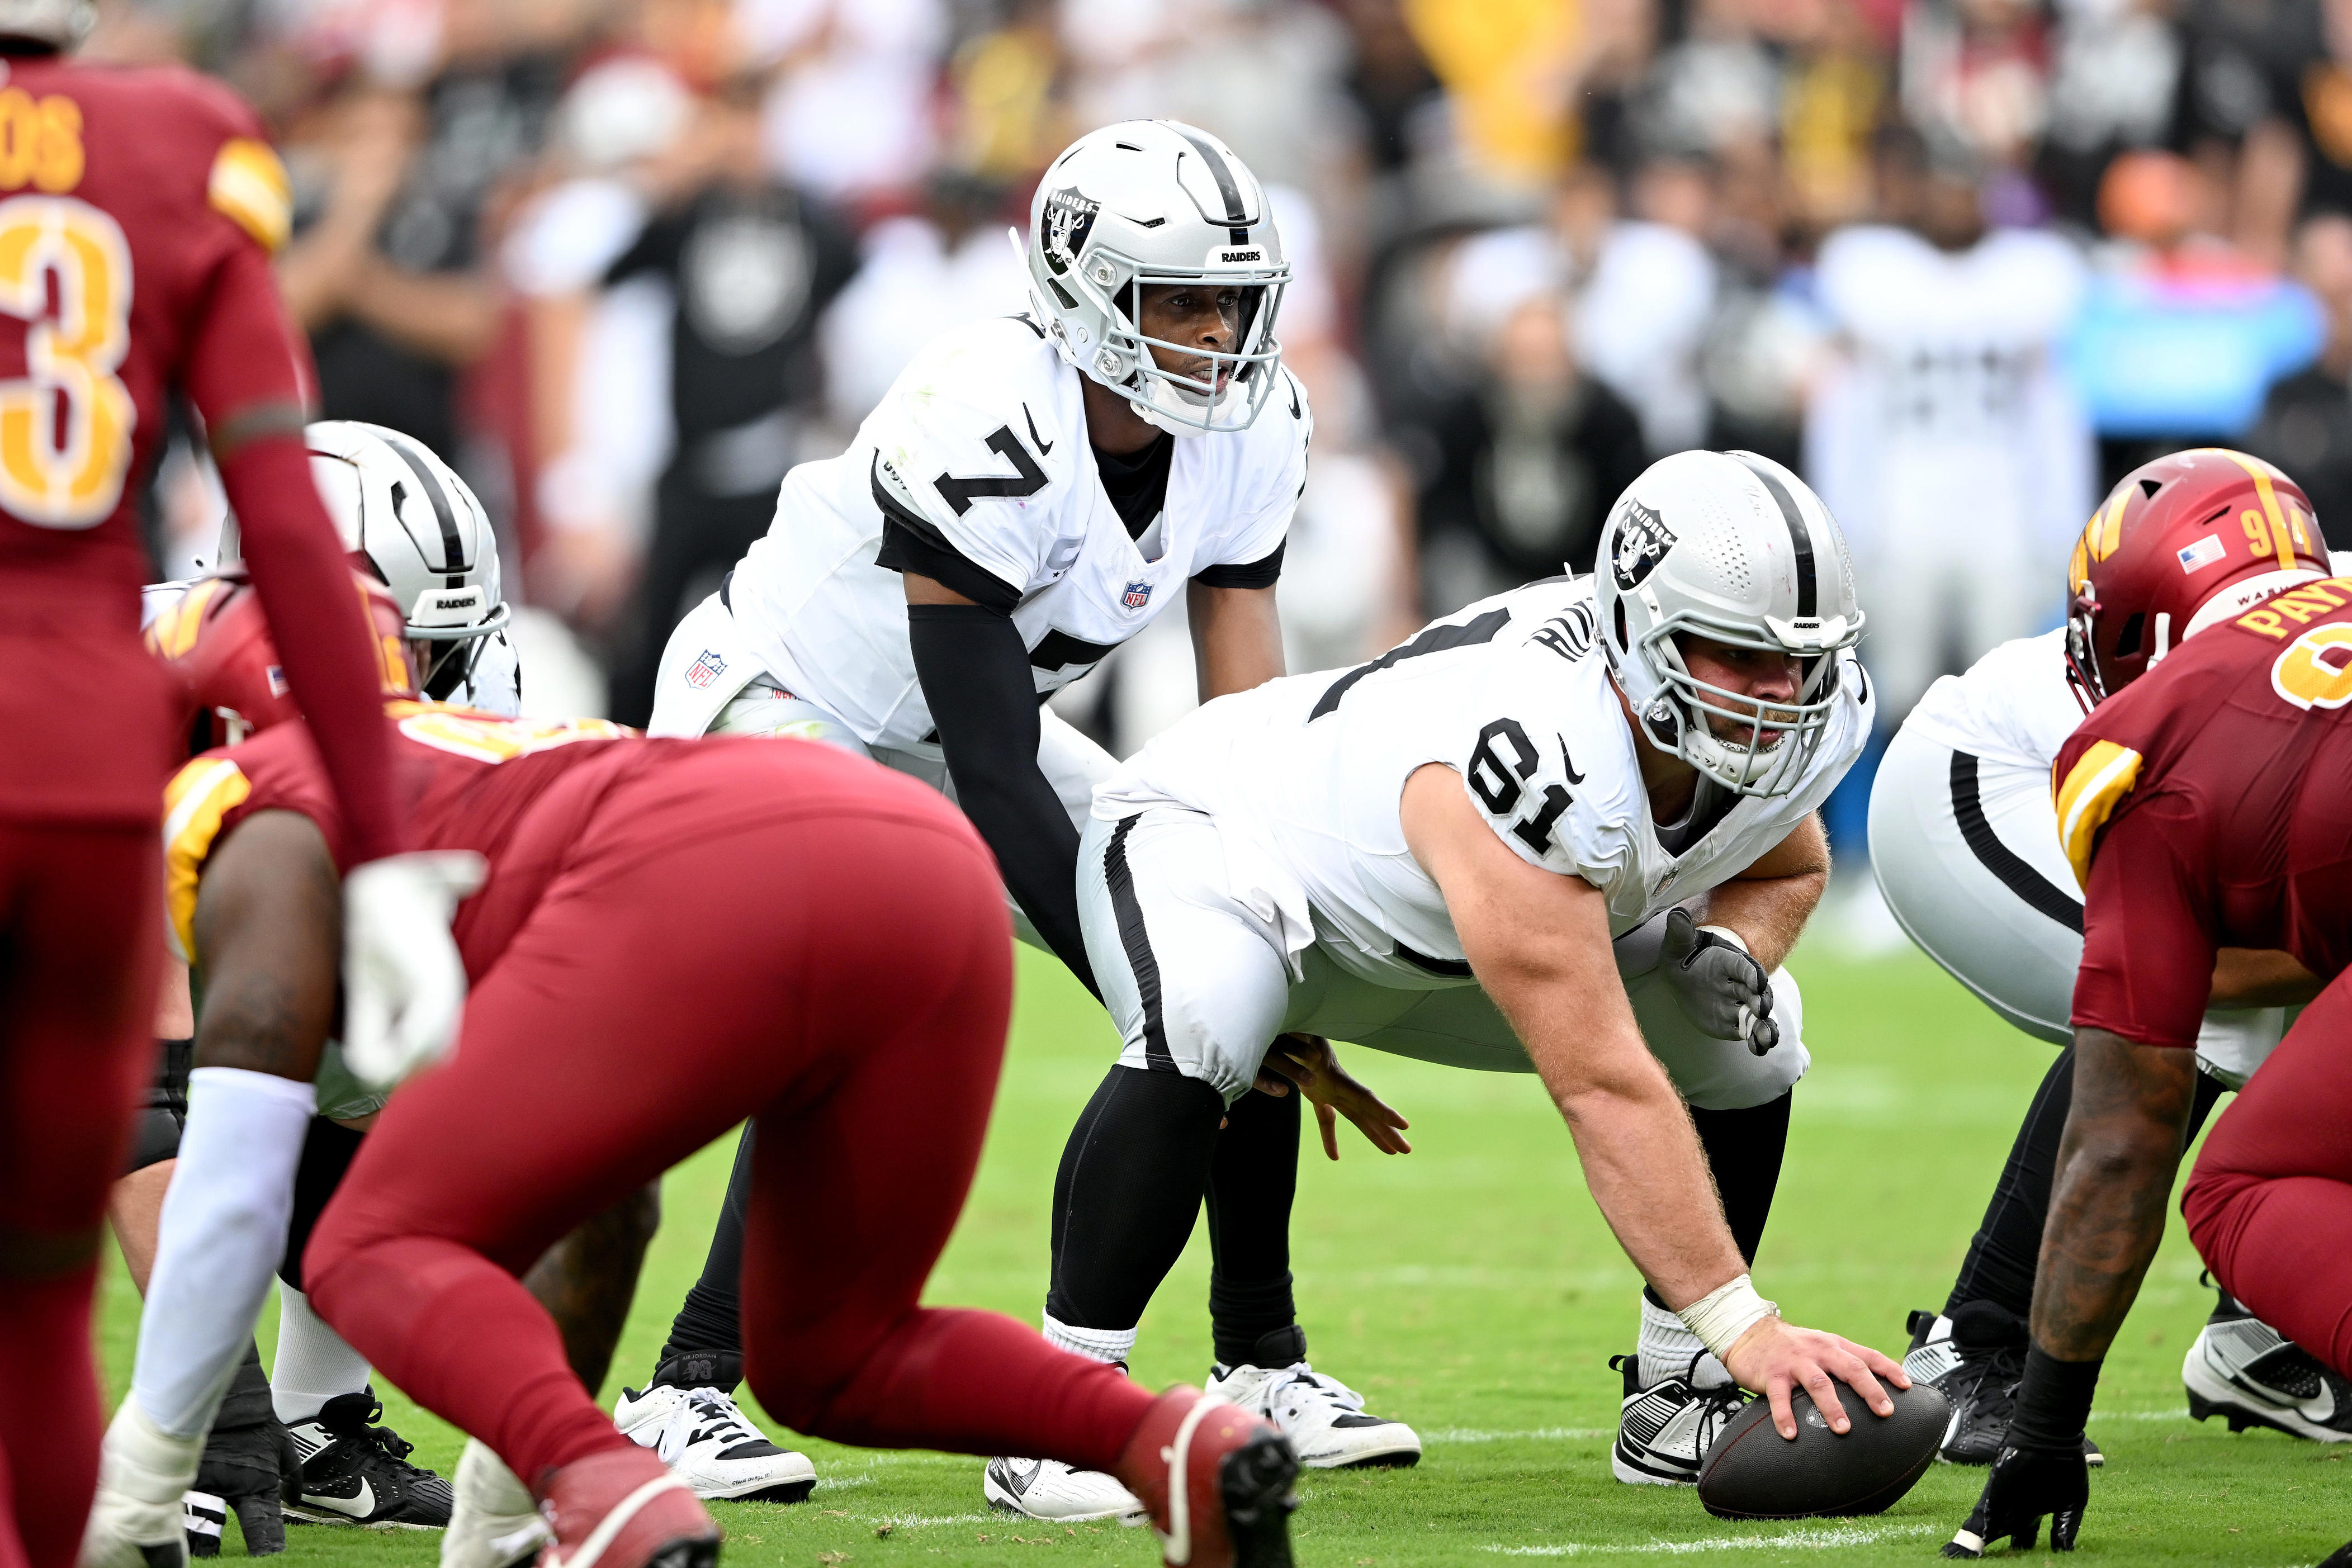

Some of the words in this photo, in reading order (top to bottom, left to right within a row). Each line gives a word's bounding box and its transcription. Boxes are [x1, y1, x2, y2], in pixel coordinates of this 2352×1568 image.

[1051, 191, 1094, 212] RAIDERS
[1222, 251, 1260, 262] RAIDERS
[930, 422, 1051, 522] 7
[1630, 503, 1672, 545] RAIDERS
[1125, 593, 1145, 607] NFL
[689, 663, 713, 687] NFL
[1466, 717, 1575, 861] 61
